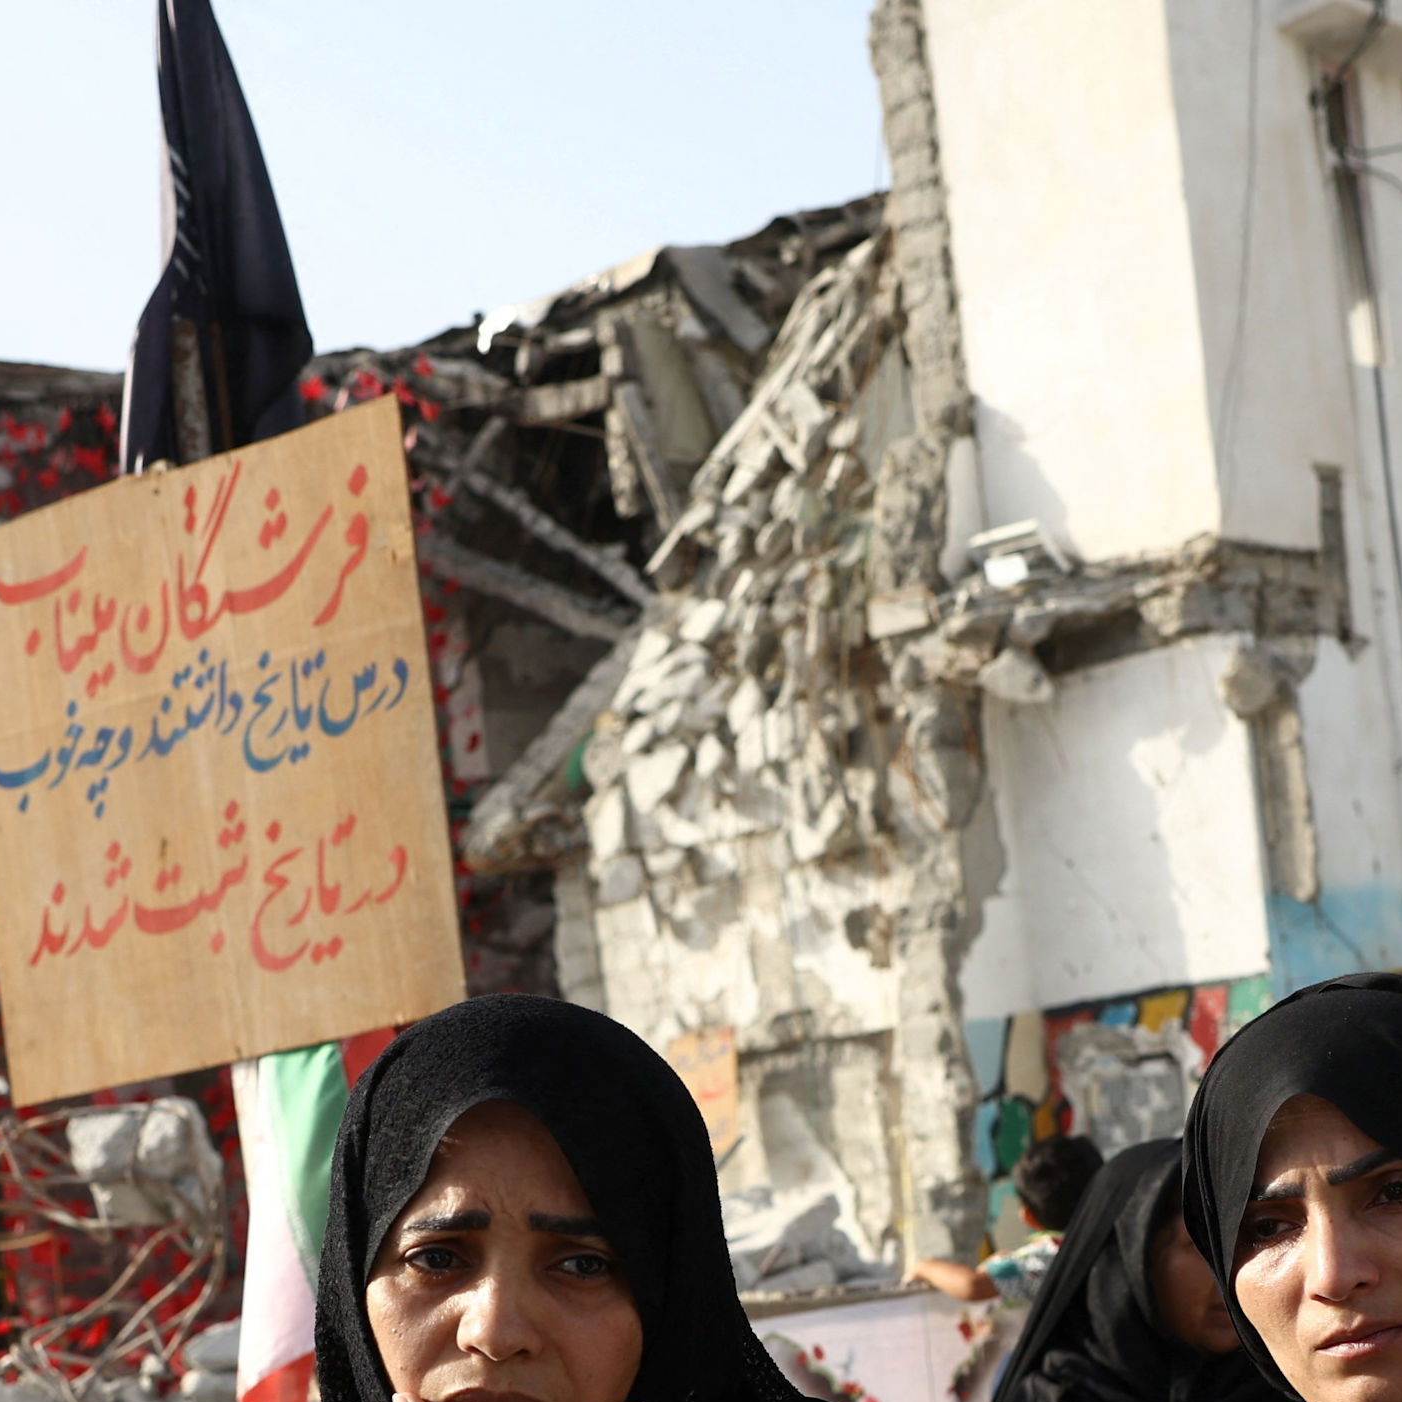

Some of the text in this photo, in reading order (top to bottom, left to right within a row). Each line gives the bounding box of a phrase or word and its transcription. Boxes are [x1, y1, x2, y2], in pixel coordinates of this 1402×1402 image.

[119, 459, 371, 675] فرشتگان
[136, 648, 245, 763] داشتند
[243, 648, 326, 773] تاریخ
[318, 656, 409, 737] درس
[28, 799, 409, 973] در تاریخ ثبت شدند
